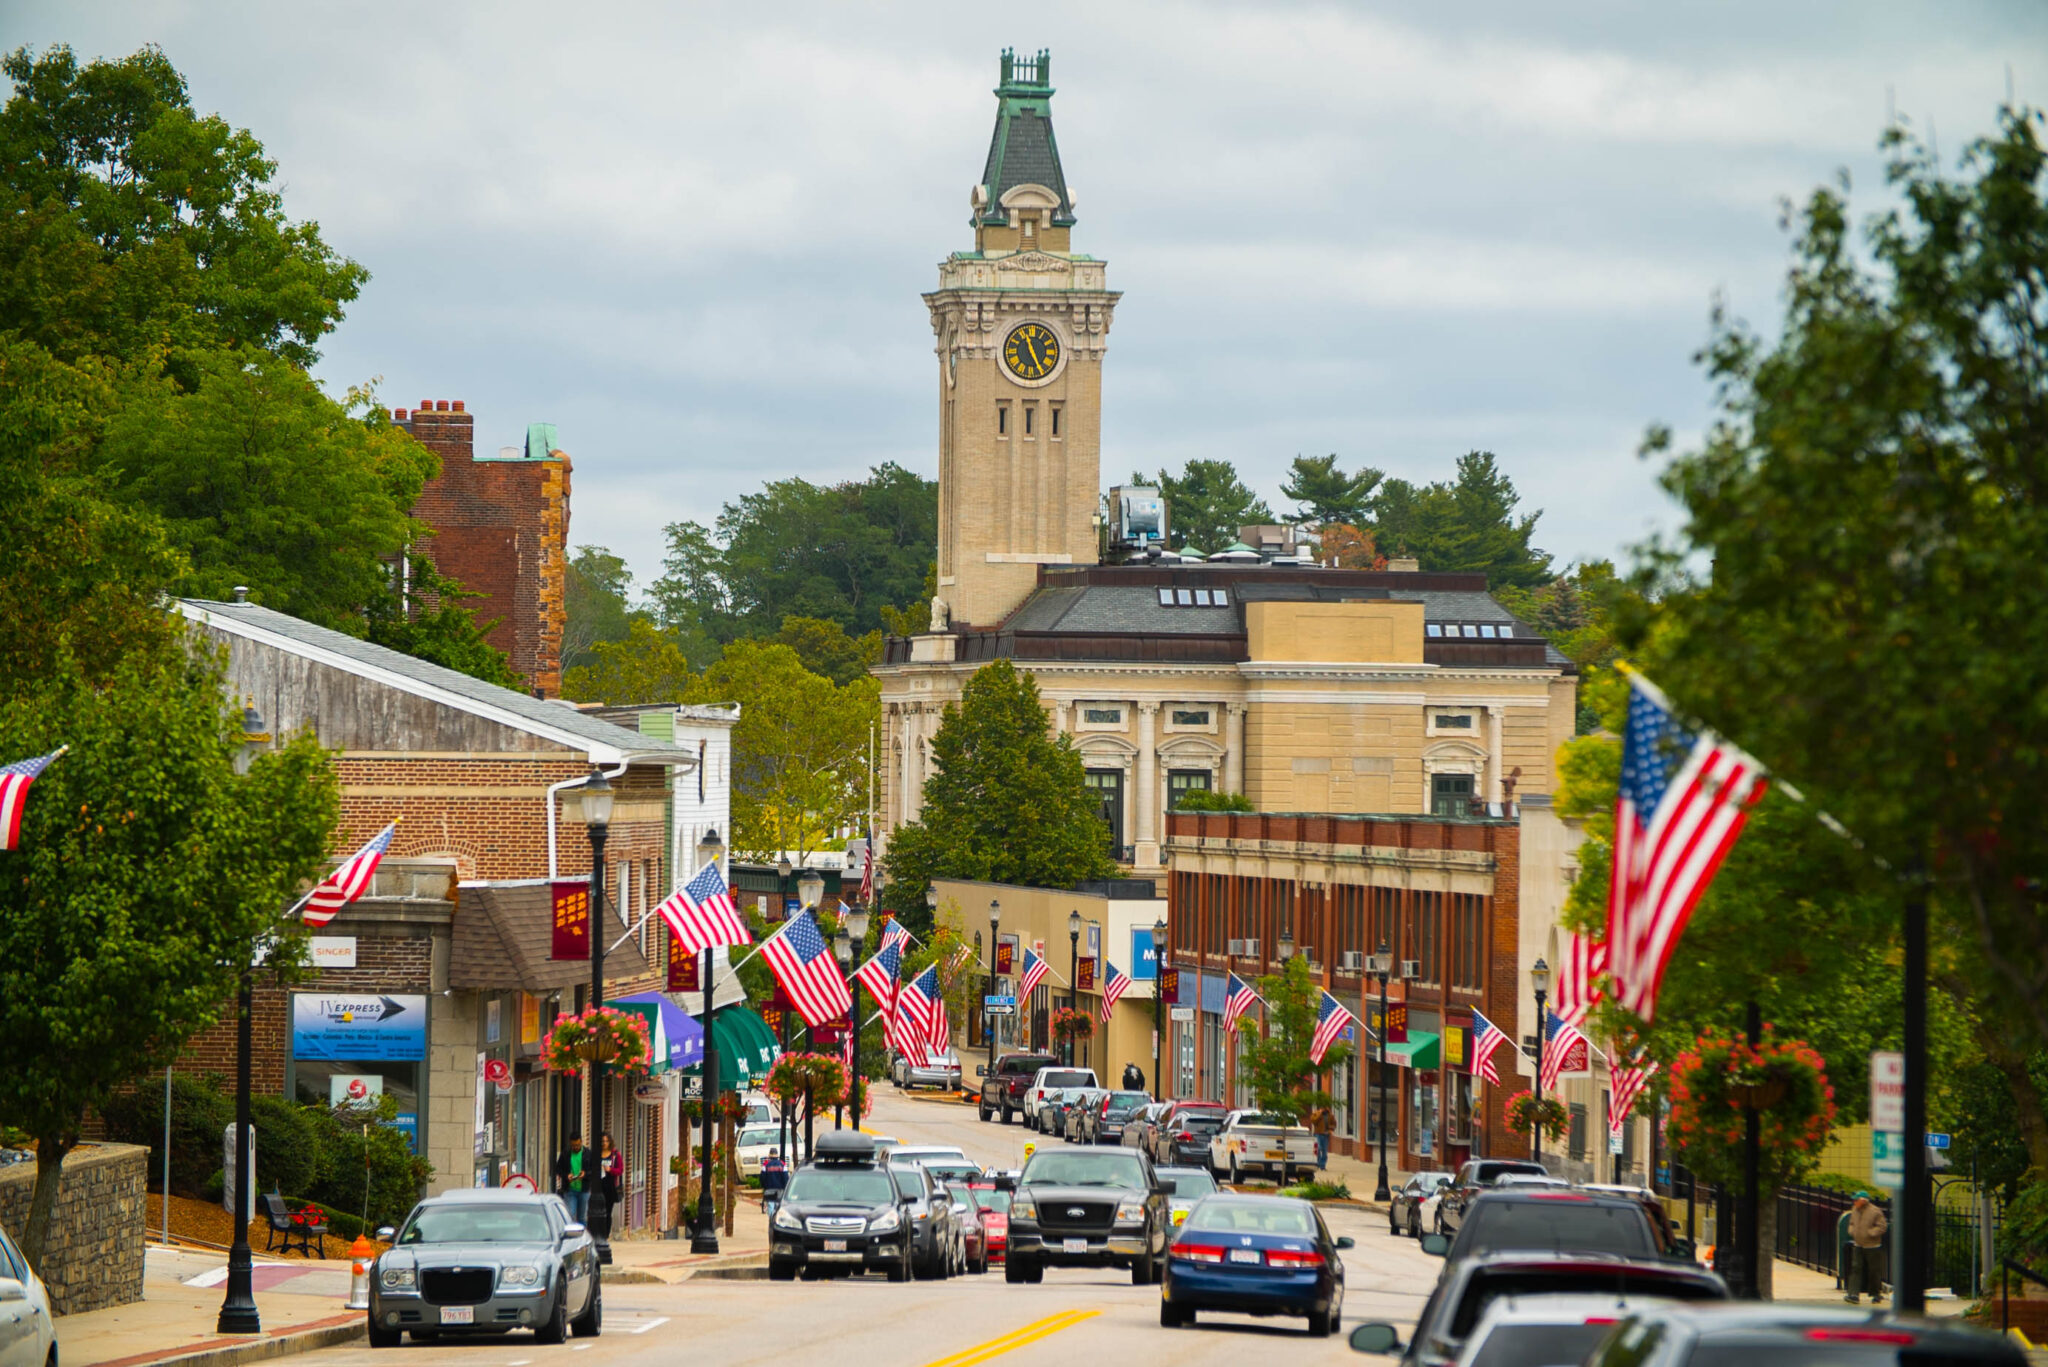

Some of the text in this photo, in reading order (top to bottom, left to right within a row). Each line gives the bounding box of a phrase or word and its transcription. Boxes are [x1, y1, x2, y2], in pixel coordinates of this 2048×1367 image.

[316, 948, 352, 956] SINGER
[1143, 949, 1168, 960] Mr
[335, 1004, 381, 1012] EXPRESS
